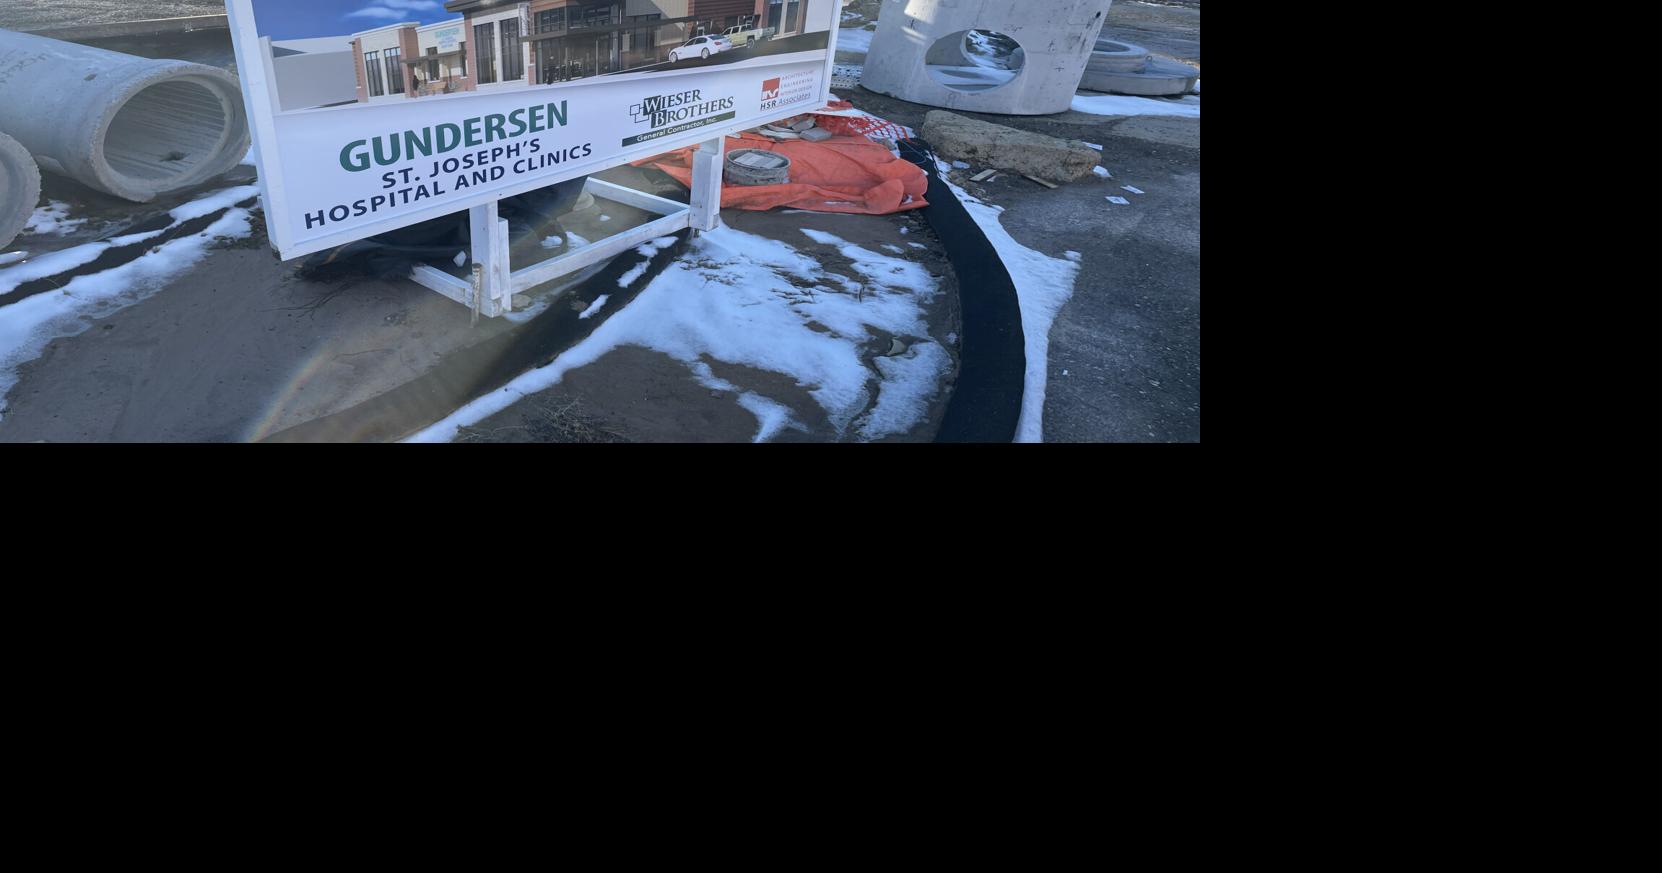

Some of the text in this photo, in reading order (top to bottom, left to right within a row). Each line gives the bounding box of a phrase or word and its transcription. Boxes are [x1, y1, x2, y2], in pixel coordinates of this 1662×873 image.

[644, 89, 702, 112] WIESER
[653, 96, 734, 128] BROTHERS
[760, 92, 811, 111] HSR Associates
[339, 100, 569, 173] GUNDERSEN
[637, 117, 718, 142] General Contractor, Inc.
[382, 138, 541, 189] ST. JOSEPH'S
[305, 143, 593, 230] HOSPITAL AND CLINICS
